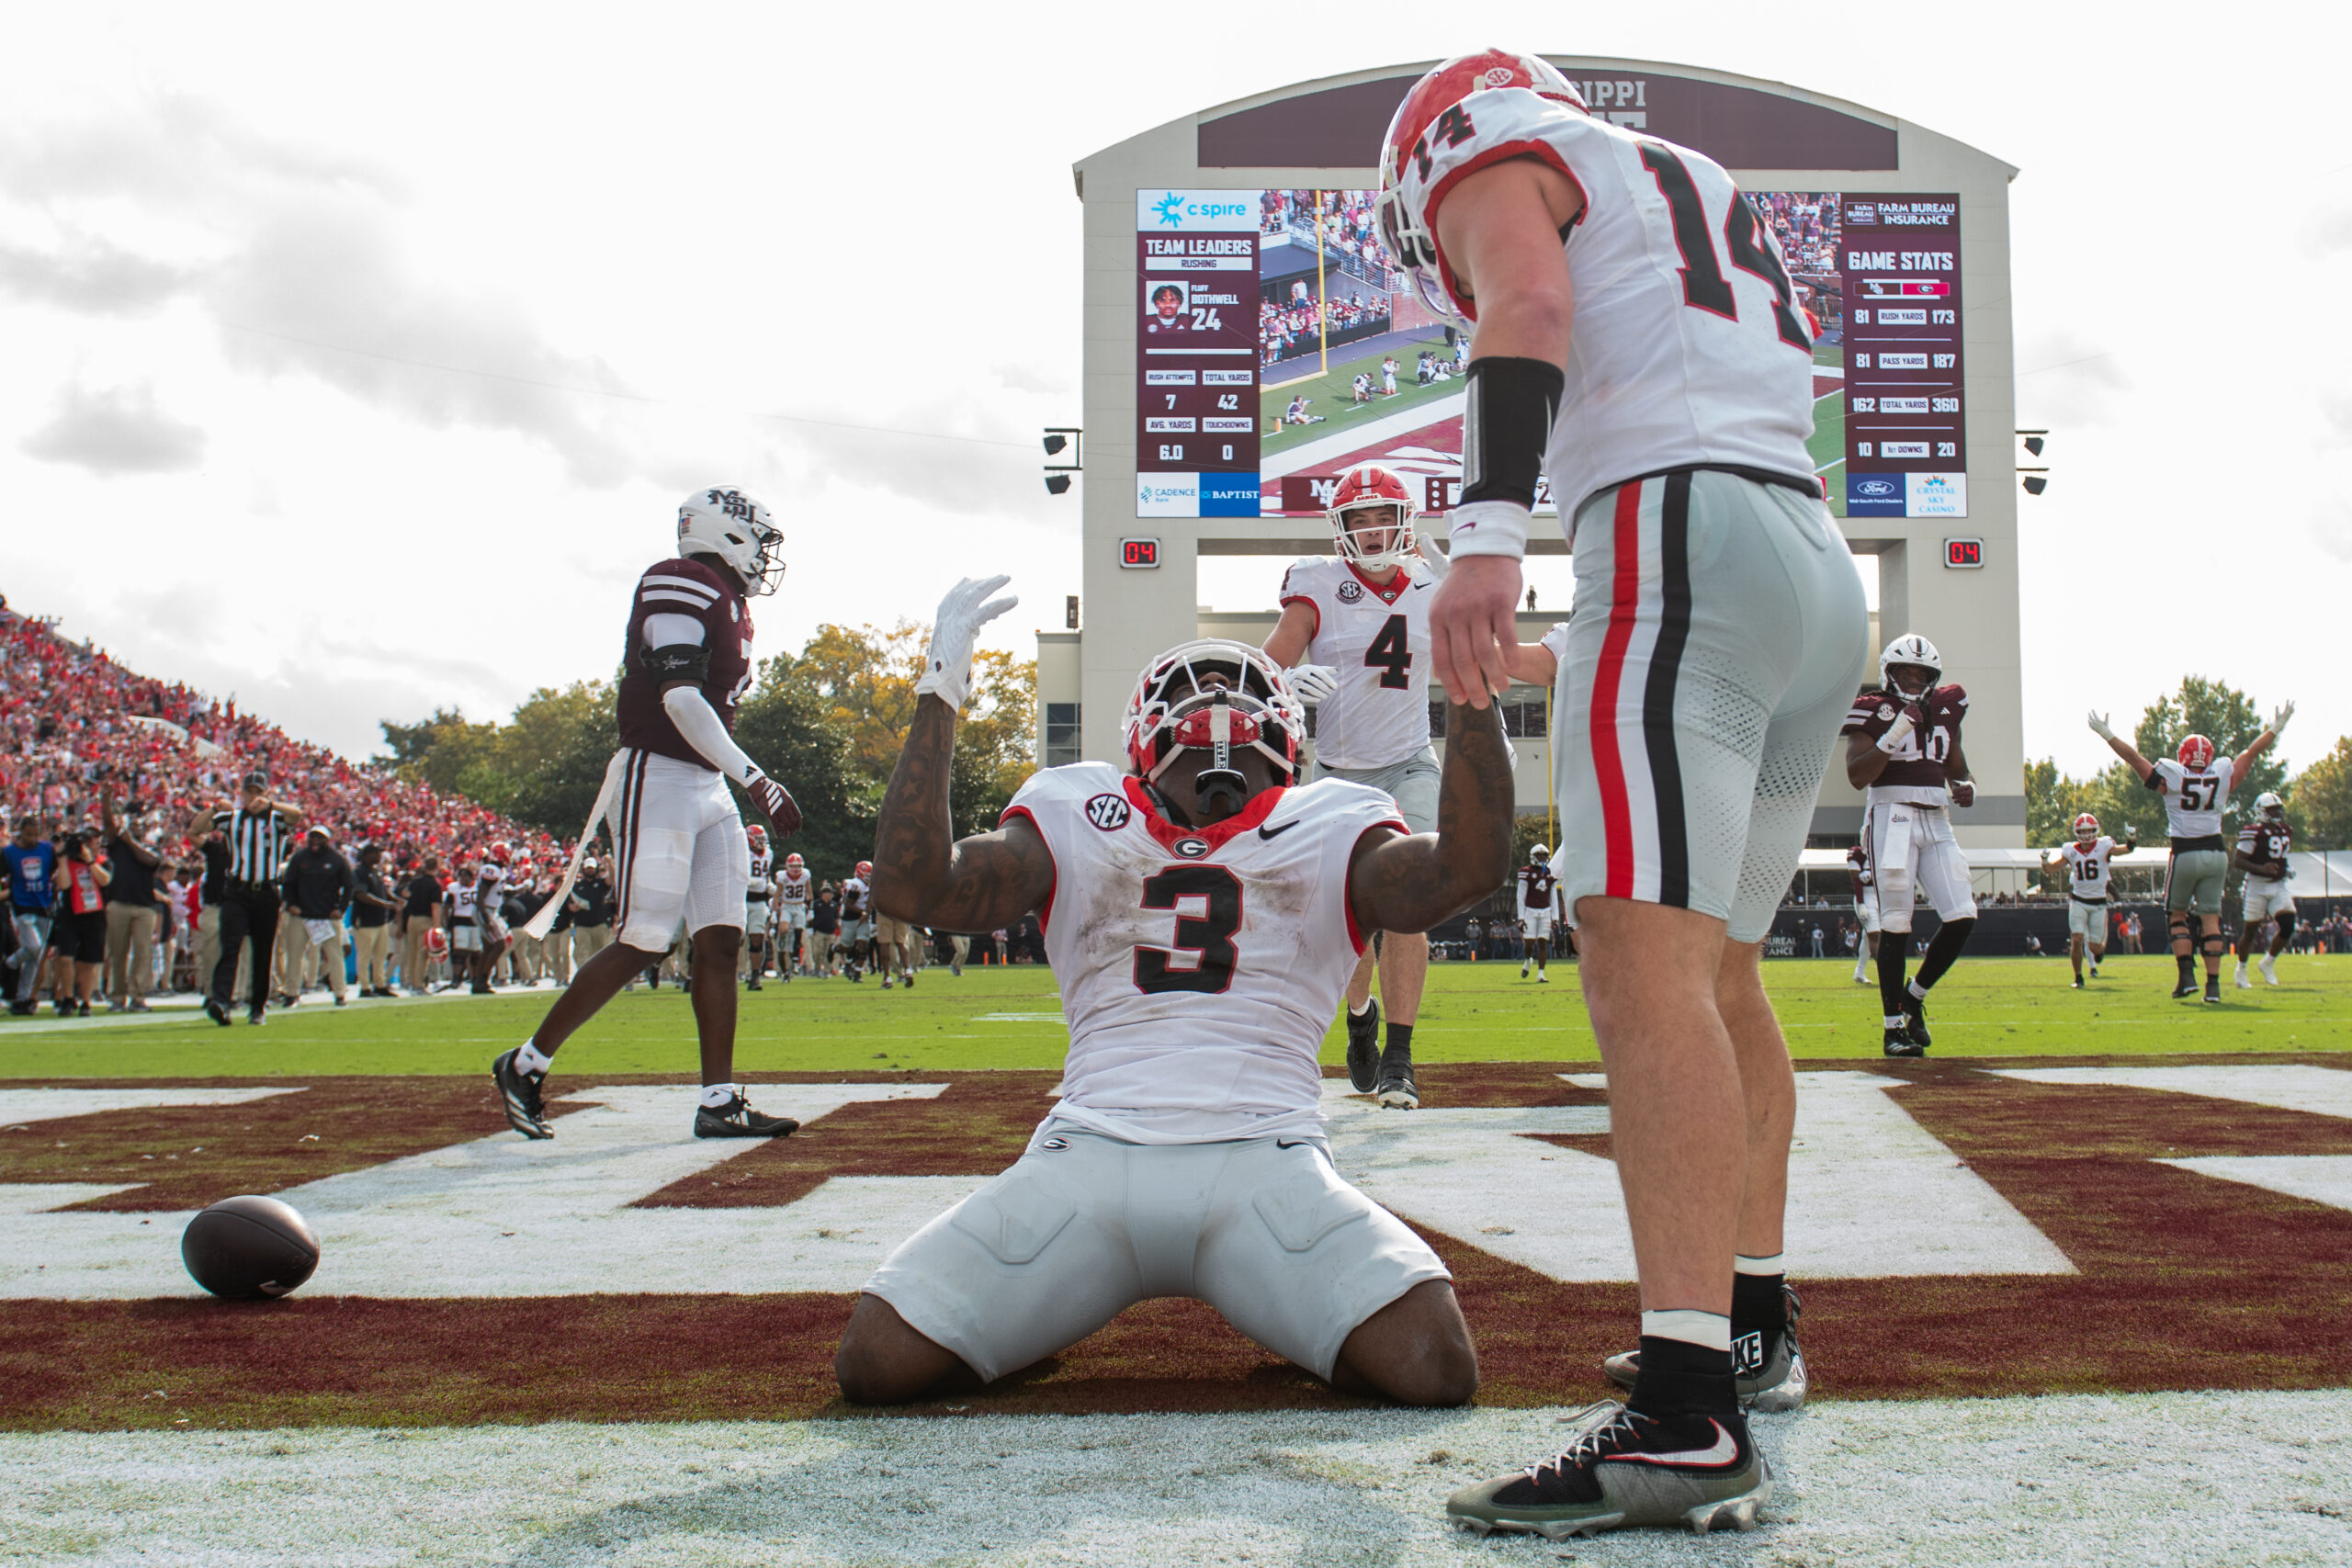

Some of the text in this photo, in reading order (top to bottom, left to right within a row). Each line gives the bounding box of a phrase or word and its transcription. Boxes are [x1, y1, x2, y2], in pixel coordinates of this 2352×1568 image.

[1412, 102, 1476, 185] 14
[1201, 204, 1246, 219] spire
[1878, 203, 1955, 213] FARM BUREAU
[1884, 216, 1949, 225] INSURANCE
[1146, 240, 1252, 255] TEAM LEADERS
[1633, 140, 1815, 355] 14
[1182, 259, 1216, 268] RUSHING
[1849, 252, 1953, 270] GAME STATS
[1191, 294, 1239, 305] BOTHWELL
[1191, 308, 1222, 331] 24
[1855, 309, 1870, 324] 81
[1932, 310, 1955, 324] 173
[1856, 353, 1871, 368] 81
[1933, 354, 1956, 368] 187
[1165, 394, 1176, 410] 7
[1217, 394, 1238, 410] 42
[1852, 397, 1875, 412] 162
[1882, 400, 1927, 409] TOTAL YARDS
[1932, 398, 1959, 412] 360
[1150, 421, 1193, 429] AVG. YARDS
[1205, 421, 1250, 429] TOUCHDOWNS
[1159, 445, 1183, 460] 6.0
[1222, 445, 1233, 460] 0
[1858, 442, 1872, 457] 10
[1898, 446, 1923, 454] DOWNS
[1937, 442, 1956, 457] 20
[1155, 489, 1196, 497] CADENCE
[1212, 491, 1260, 499] BAPTIST
[1538, 482, 1555, 504] 2
[1125, 542, 1154, 563] 04
[1951, 543, 1979, 563] 04
[1340, 581, 1360, 599] SEC
[1364, 614, 1412, 691] 4
[2180, 776, 2220, 812] 57
[1088, 795, 1129, 829] SEC
[752, 861, 768, 877] 64
[2075, 859, 2098, 881] 16
[786, 885, 804, 898] 32
[1134, 864, 1243, 994] 3
[1730, 1333, 1761, 1373] KE
